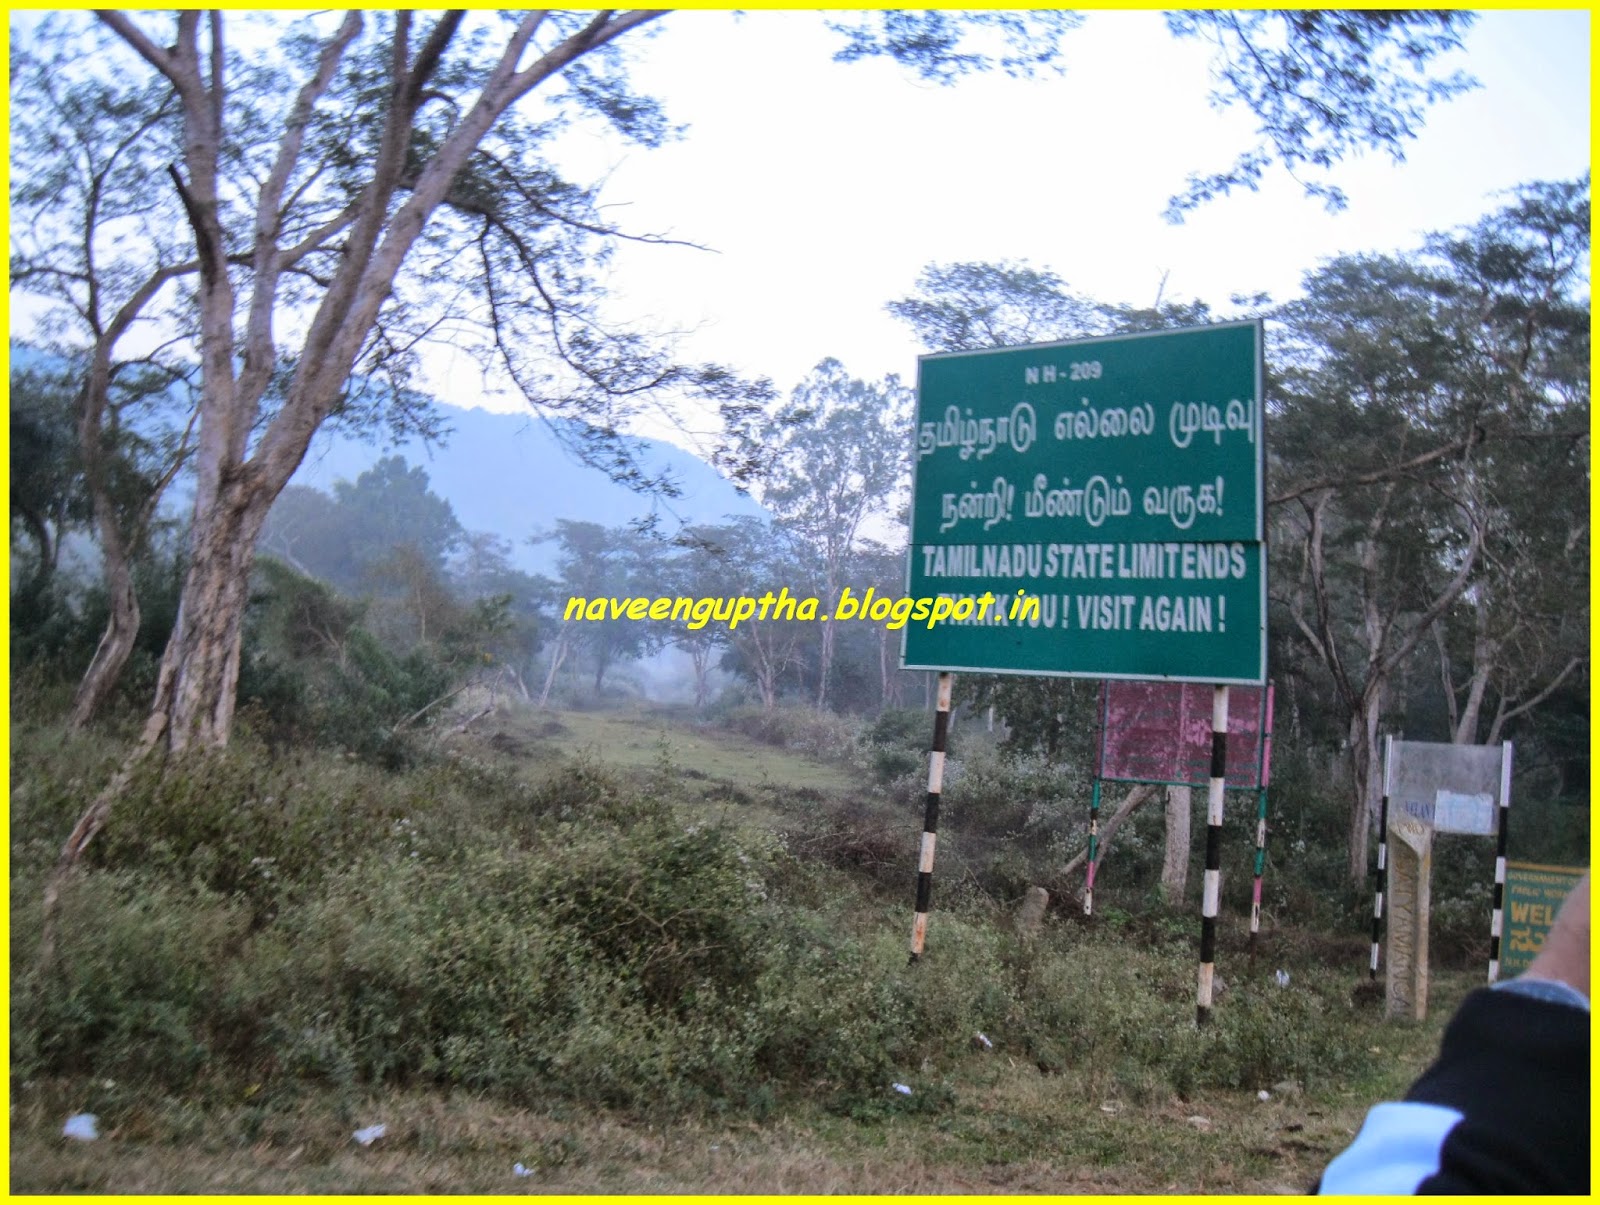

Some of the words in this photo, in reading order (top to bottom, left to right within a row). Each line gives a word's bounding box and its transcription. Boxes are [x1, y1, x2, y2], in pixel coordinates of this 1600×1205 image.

[918, 401, 1037, 461] தமிழ்நாடு
[1054, 397, 1155, 440] எல்லை
[1169, 398, 1256, 448] முடிவு
[940, 476, 1014, 533] நன்றி!
[1025, 473, 1132, 527] மீண்டும்
[1143, 475, 1225, 530] வருக!
[922, 543, 1043, 579] TAMILNADU
[1044, 543, 1115, 579] STATE
[1118, 542, 1179, 580] LIMIT
[1181, 542, 1247, 580] ENDS
[1076, 595, 1136, 631] VISIT
[1139, 595, 1212, 632] AGAIN
